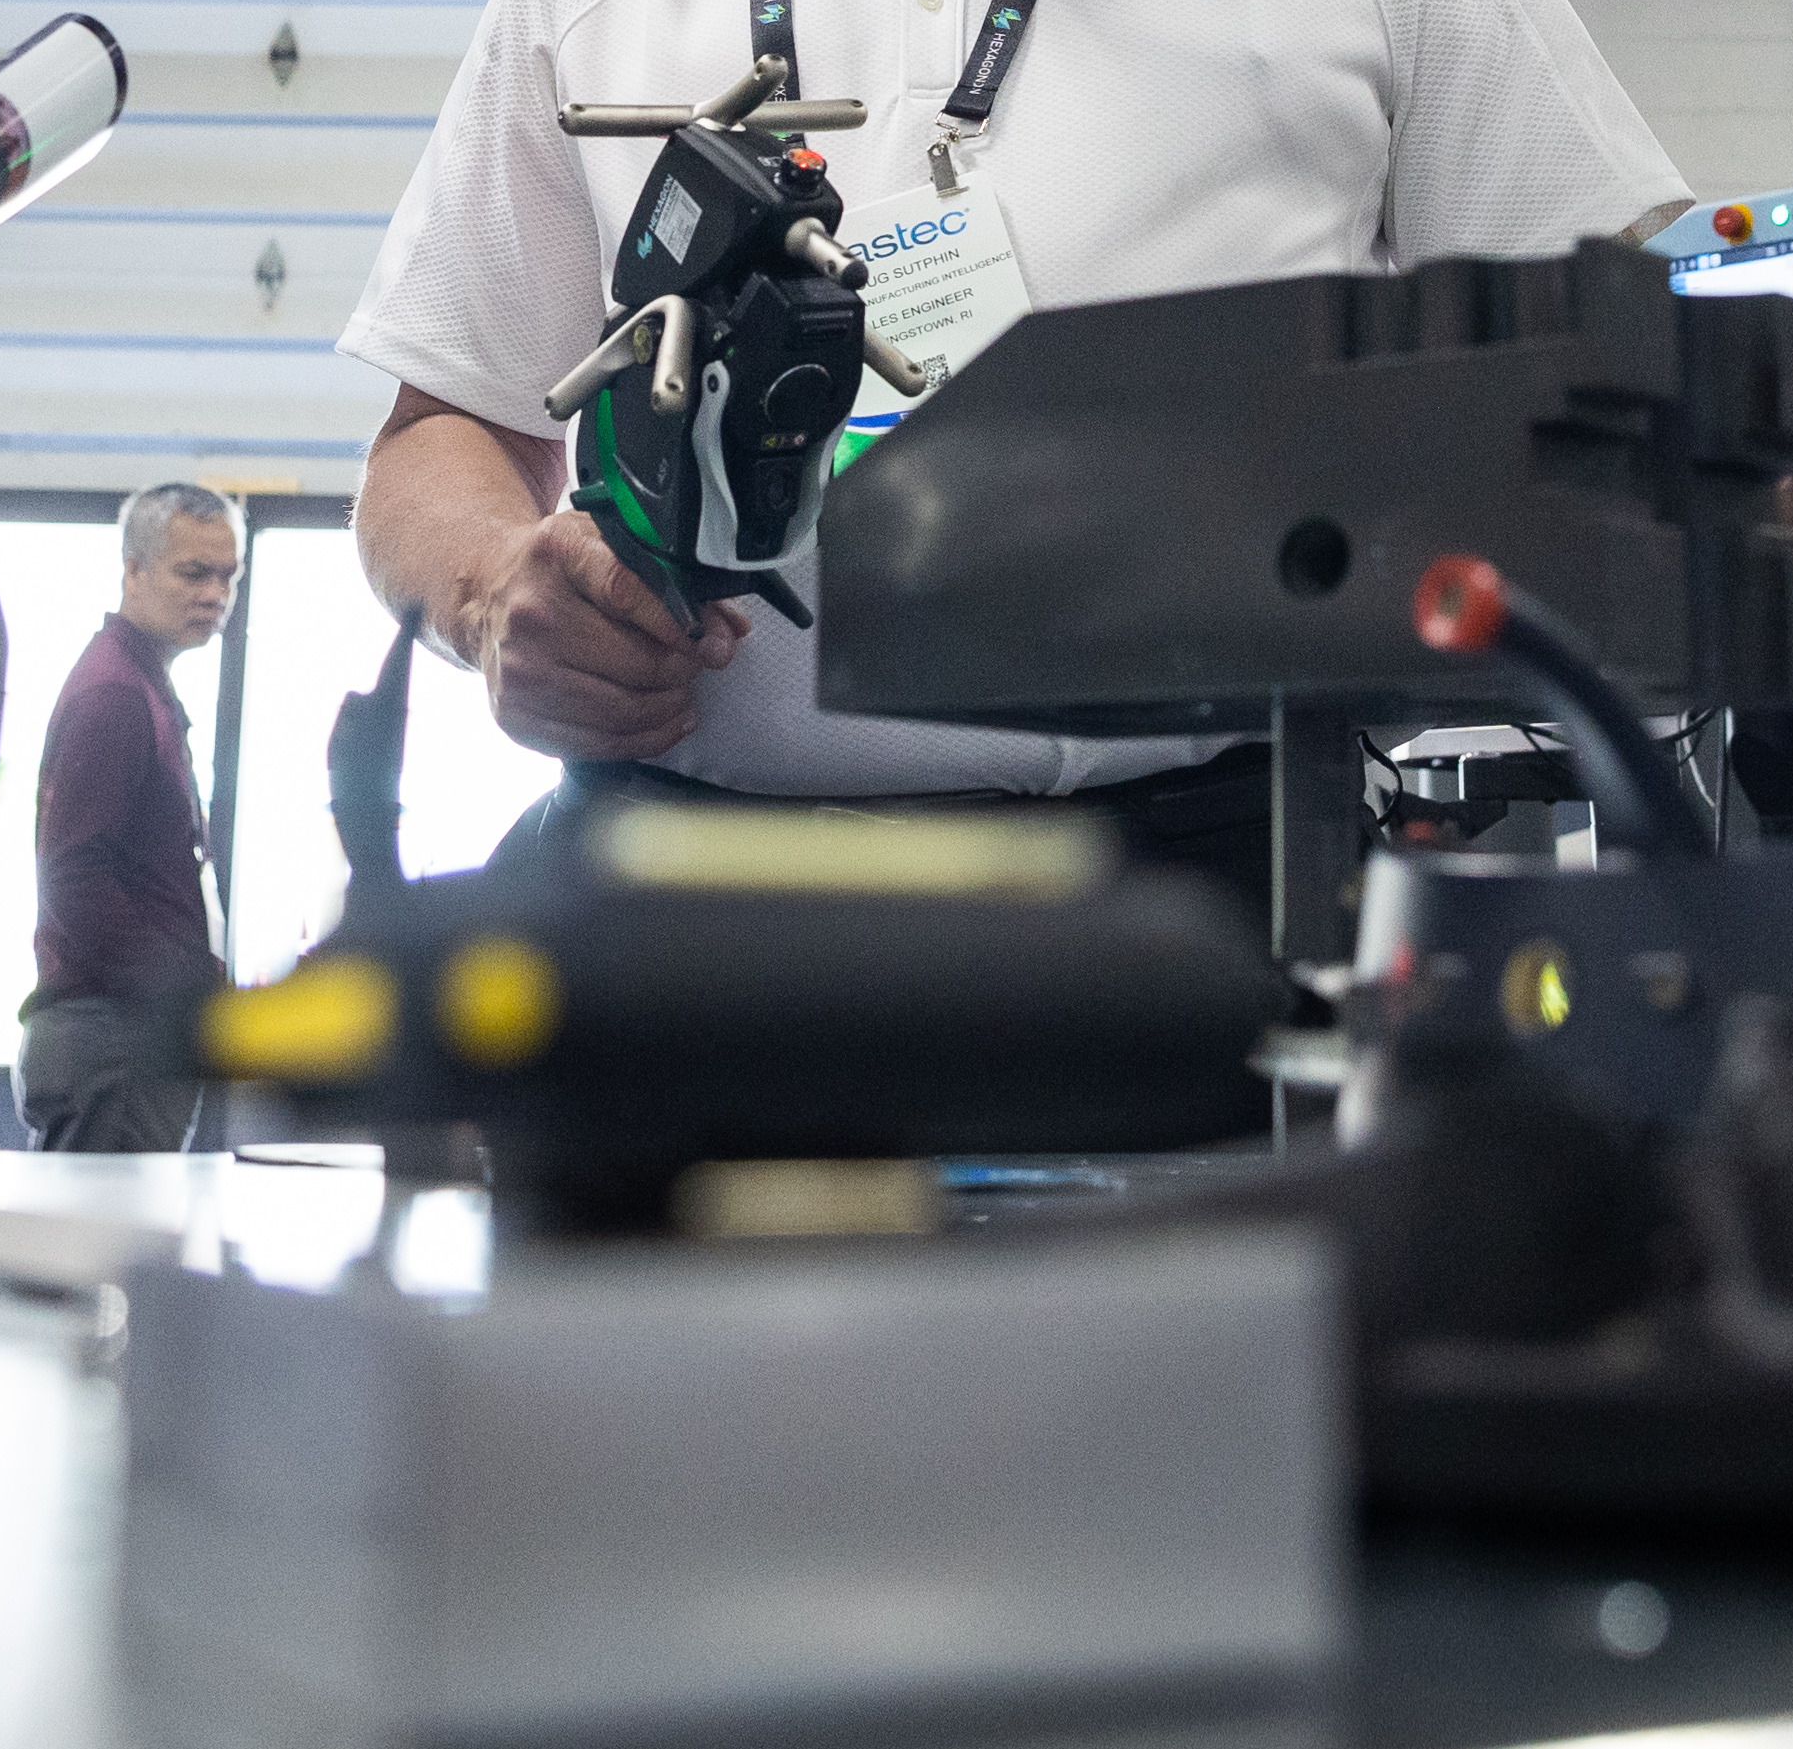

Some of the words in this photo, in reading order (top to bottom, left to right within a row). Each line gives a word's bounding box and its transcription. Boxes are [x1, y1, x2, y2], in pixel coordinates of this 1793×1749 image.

[648, 173, 674, 232] HEXAGON
[847, 211, 968, 263] astec
[866, 272, 890, 289] UG
[894, 248, 960, 279] SUTPHIN
[866, 276, 940, 307] NUFACTURING
[941, 250, 1013, 281] INTELLIGENCE
[872, 312, 899, 330] LES
[902, 287, 974, 320] ENGINEER
[960, 309, 974, 321] RI
